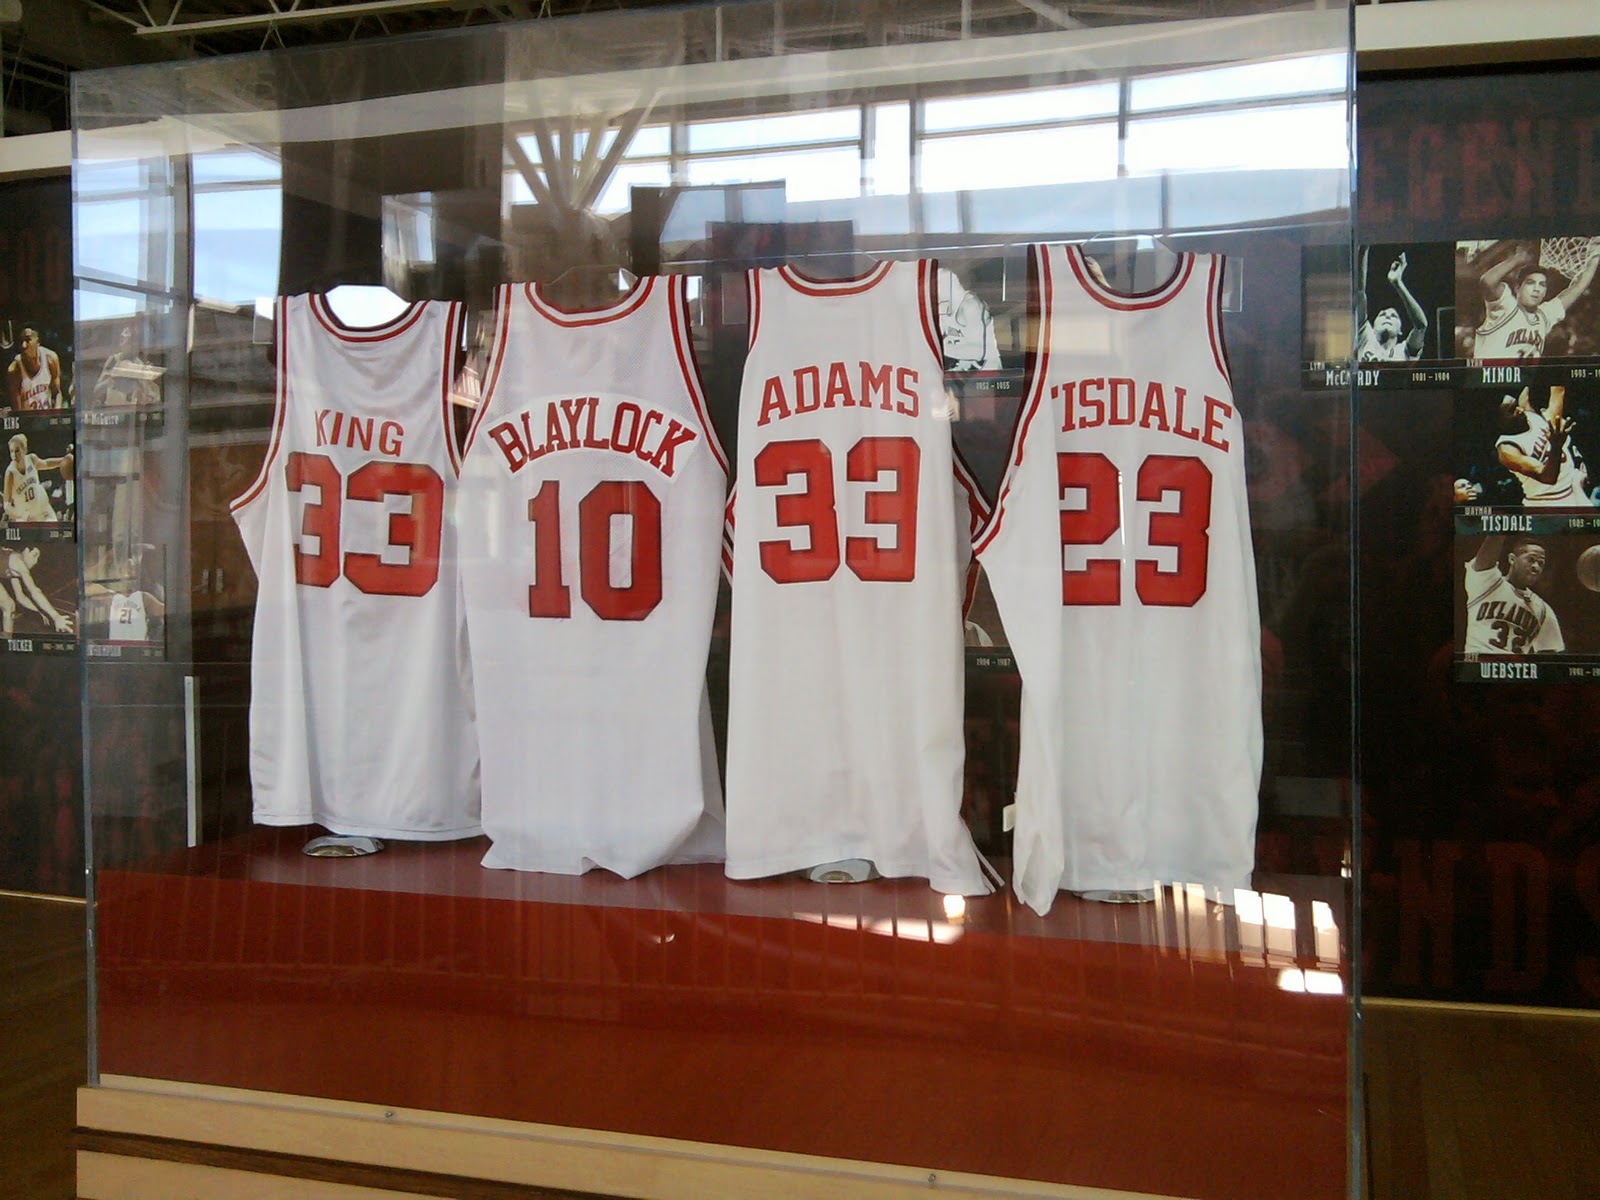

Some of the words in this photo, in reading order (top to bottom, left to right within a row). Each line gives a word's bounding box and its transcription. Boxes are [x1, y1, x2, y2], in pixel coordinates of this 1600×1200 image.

[758, 361, 920, 426] ADAMS
[1482, 366, 1521, 383] MINOR
[314, 409, 405, 457] KING
[489, 397, 697, 478] BLAYLOCK
[1052, 377, 1232, 453] ISDALE
[285, 451, 444, 597] 33
[754, 436, 920, 585] 33
[1057, 452, 1213, 607] 23
[1481, 515, 1533, 531] TISDALE
[528, 480, 663, 621] 10
[1480, 662, 1538, 679] WEBSTER
